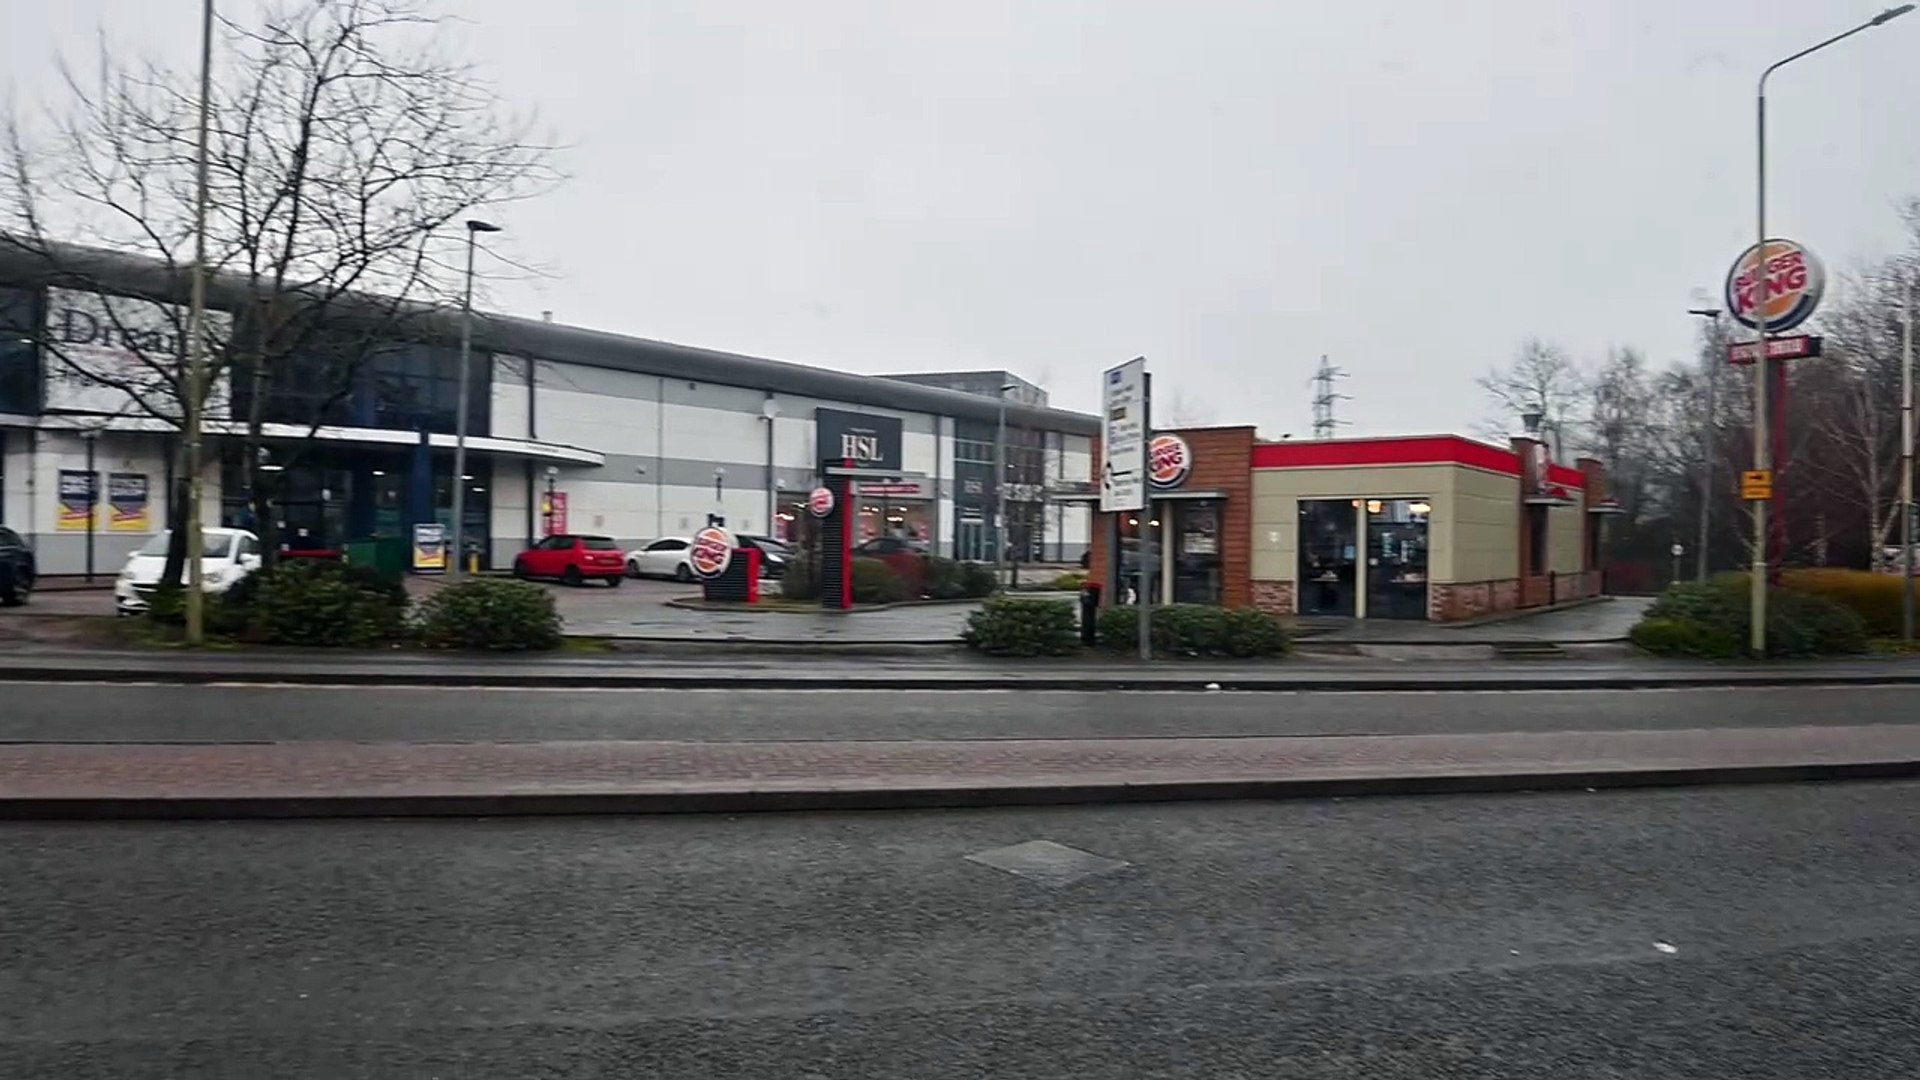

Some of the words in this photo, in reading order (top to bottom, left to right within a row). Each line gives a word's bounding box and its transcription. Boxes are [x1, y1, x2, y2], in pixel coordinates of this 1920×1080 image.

[1736, 252, 1802, 292] BUGER
[1738, 265, 1806, 315] KNG
[841, 433, 883, 461] HSL
